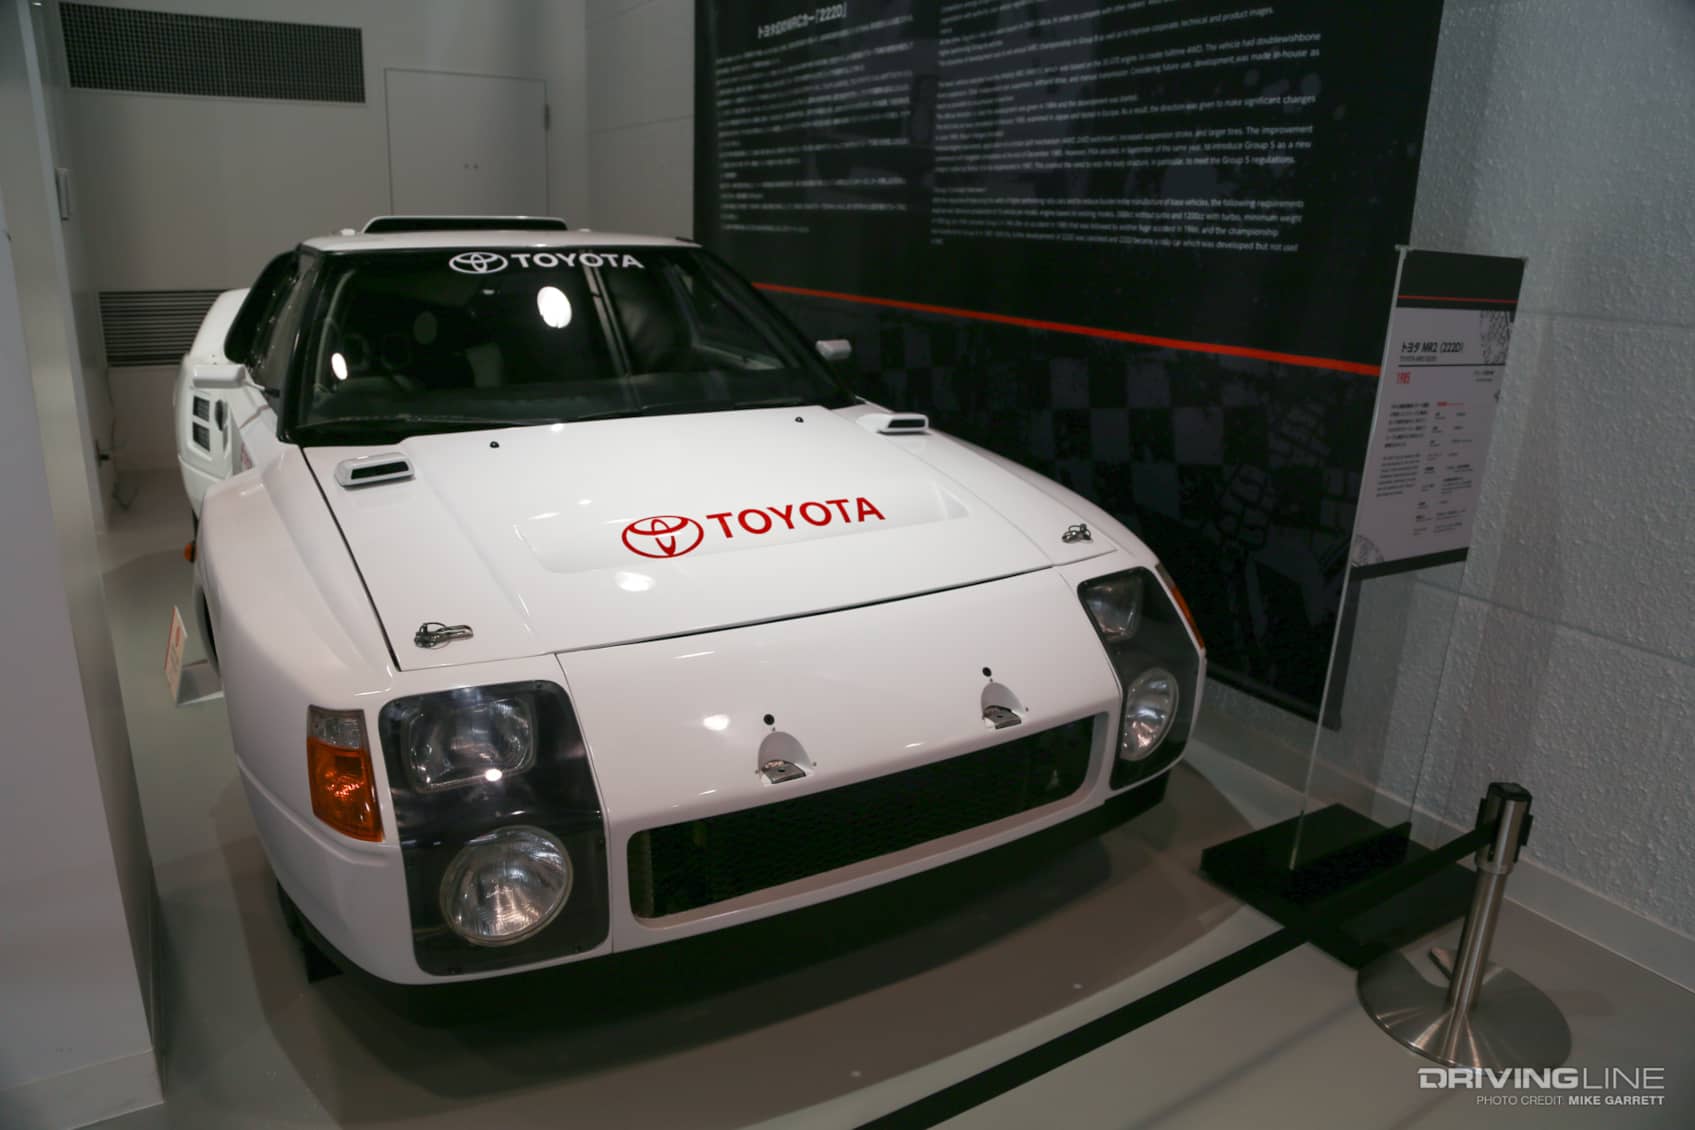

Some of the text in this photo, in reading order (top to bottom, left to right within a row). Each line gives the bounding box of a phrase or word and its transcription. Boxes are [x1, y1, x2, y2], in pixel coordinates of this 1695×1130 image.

[1244, 96, 1281, 107] significant
[1245, 141, 1269, 151] Group
[511, 253, 645, 269] TOYOTA
[706, 497, 886, 538] TOYOTA
